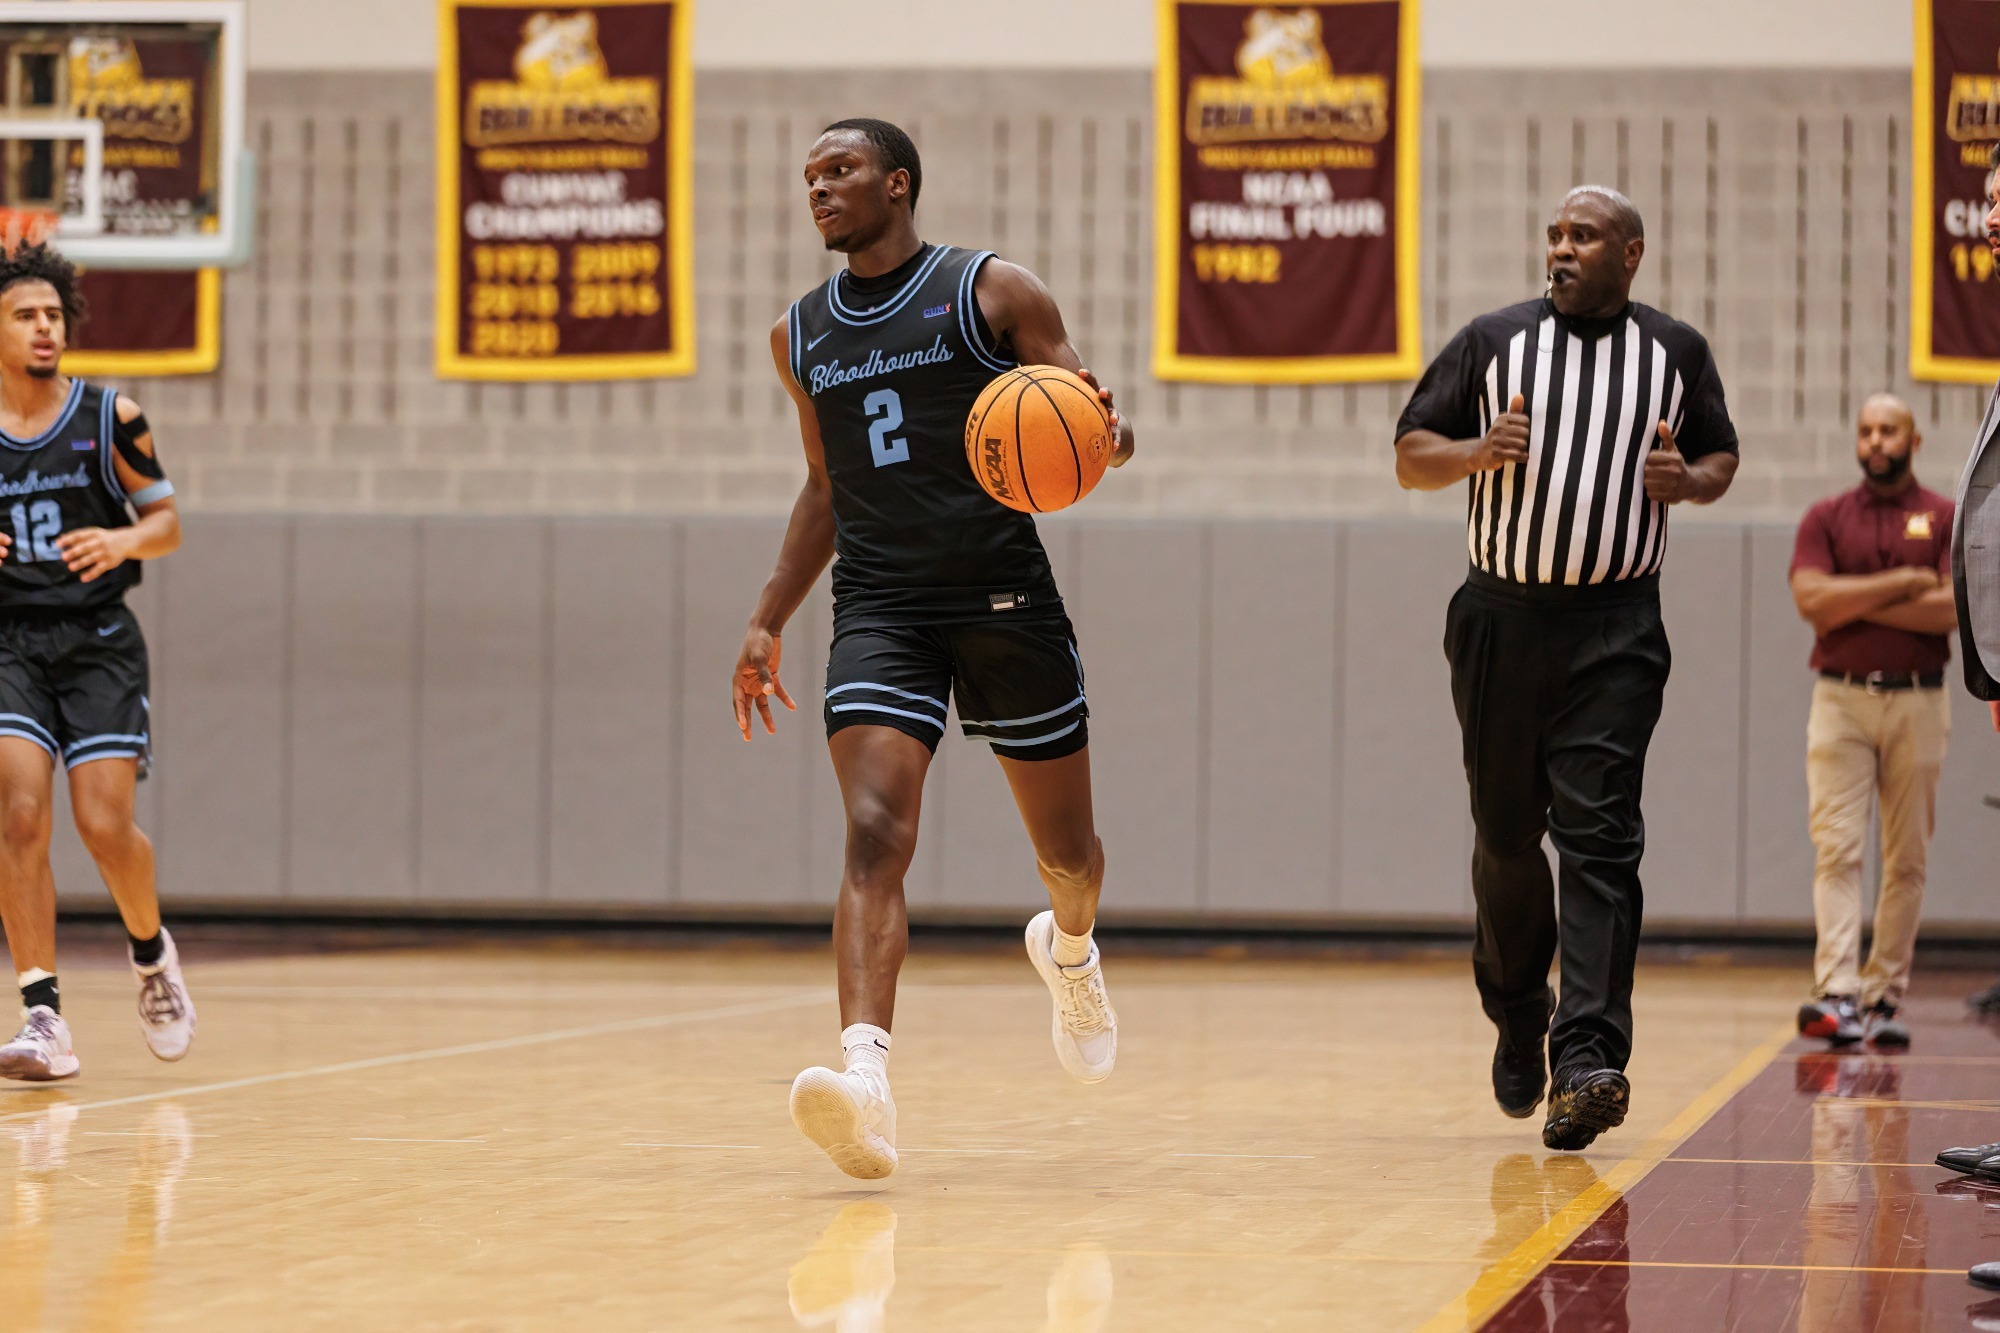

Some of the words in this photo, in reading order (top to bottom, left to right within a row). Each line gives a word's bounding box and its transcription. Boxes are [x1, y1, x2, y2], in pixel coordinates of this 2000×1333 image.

[1242, 171, 1333, 205] NCAA
[465, 200, 664, 239] CHAMPIONS
[1190, 202, 1292, 240] FINAL
[1295, 198, 1386, 238] FOUR
[1193, 245, 1281, 283] 1982
[809, 334, 954, 396] Bloodhounds
[863, 388, 910, 469] 2
[985, 438, 1015, 501] NCAA
[10, 499, 63, 563] 12
